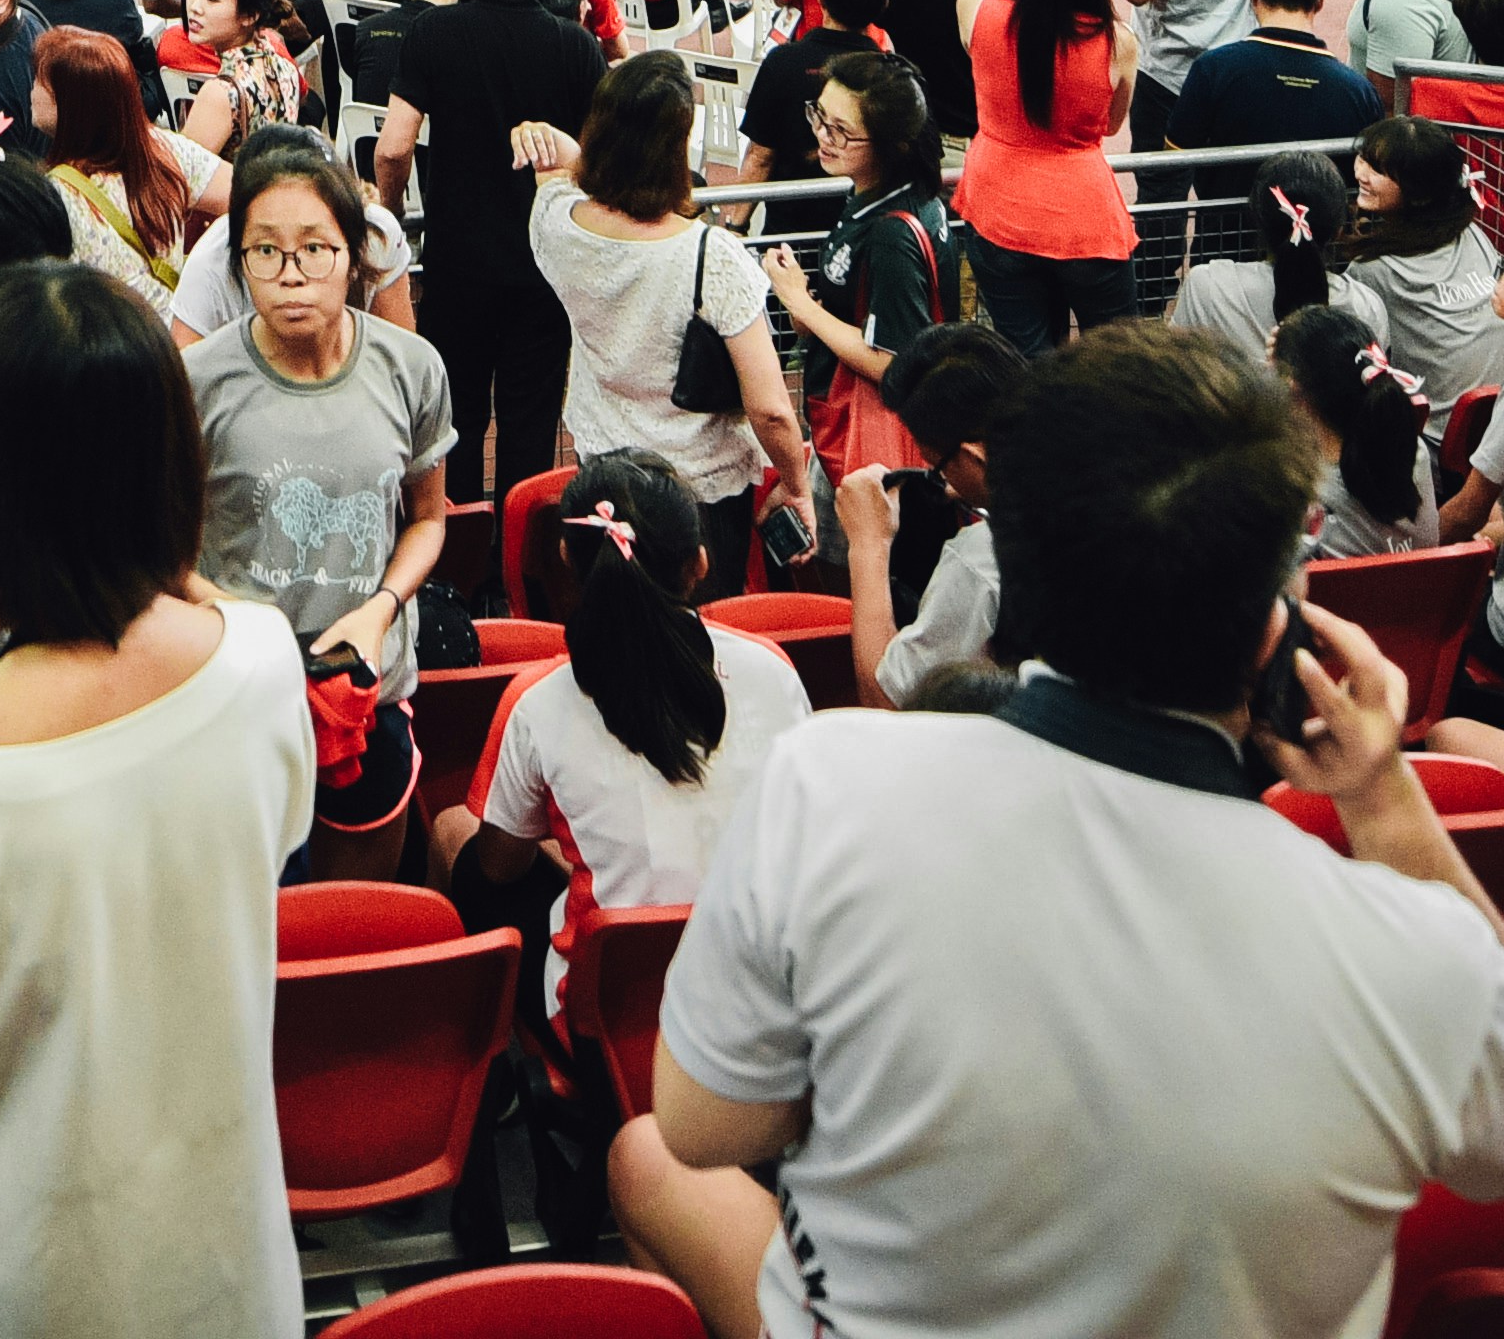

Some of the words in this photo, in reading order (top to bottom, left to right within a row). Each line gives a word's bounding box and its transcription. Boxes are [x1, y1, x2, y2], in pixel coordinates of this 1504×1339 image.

[1435, 280, 1470, 306] Boon
[249, 559, 293, 588] TRACK
[313, 566, 328, 586] &
